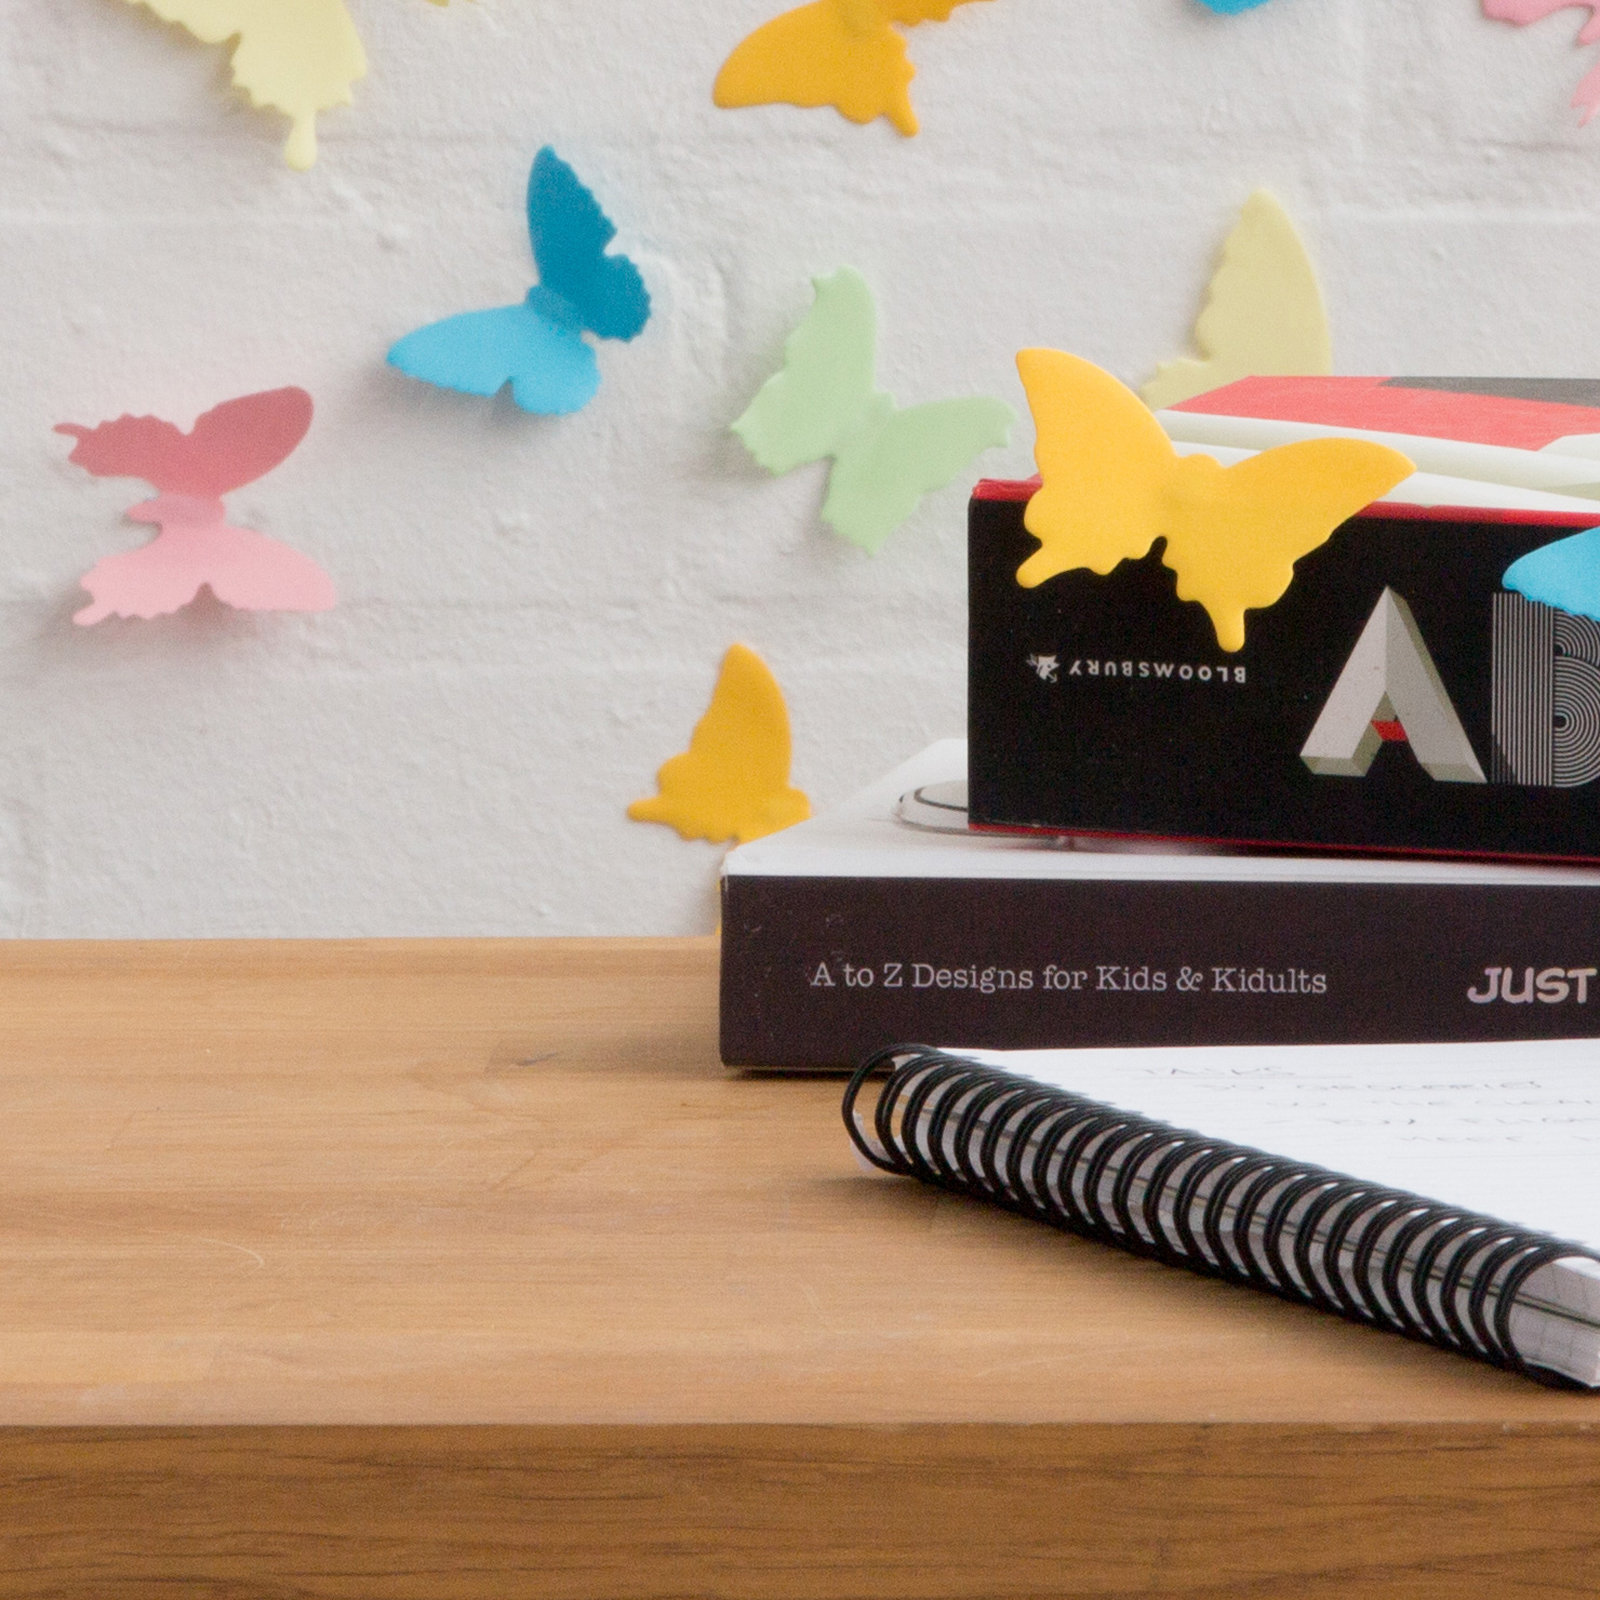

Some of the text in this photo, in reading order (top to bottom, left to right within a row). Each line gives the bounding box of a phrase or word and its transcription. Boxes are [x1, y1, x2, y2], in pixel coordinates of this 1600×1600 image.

[1069, 660, 1246, 684] BLOOMSBURY
[810, 963, 1327, 995] A to Z Designs for Kids & Kidults
[1466, 966, 1598, 1004] JUST
